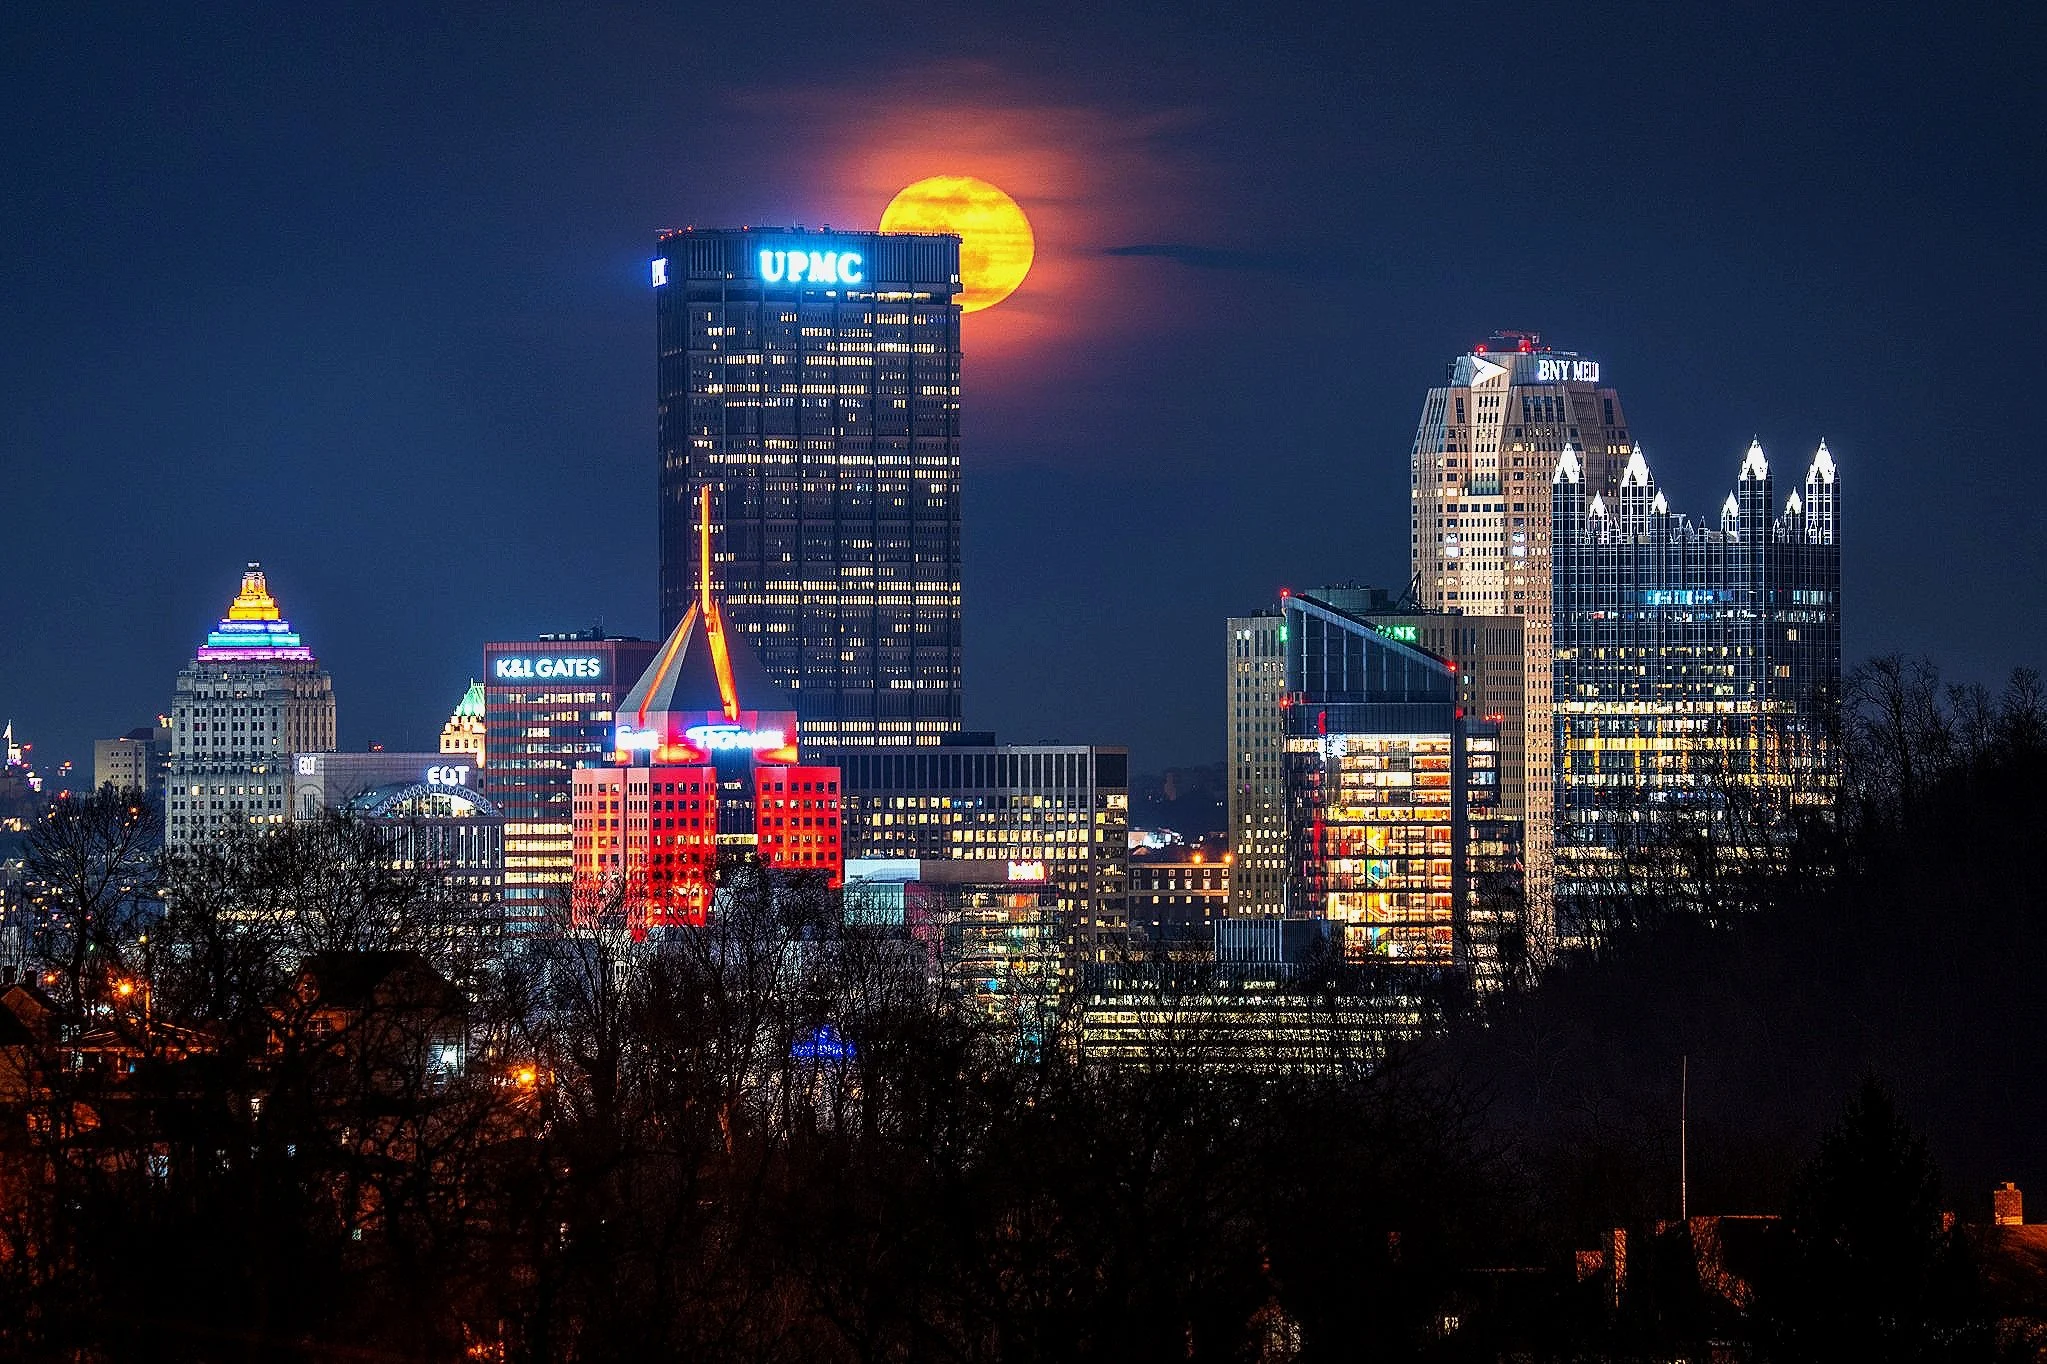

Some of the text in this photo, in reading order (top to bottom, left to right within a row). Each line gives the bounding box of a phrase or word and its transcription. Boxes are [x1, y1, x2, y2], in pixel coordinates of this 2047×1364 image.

[759, 250, 863, 283] UPMC
[1538, 359, 1570, 382] BNY
[496, 657, 601, 678] K&L GATES
[427, 765, 470, 787] EQT
